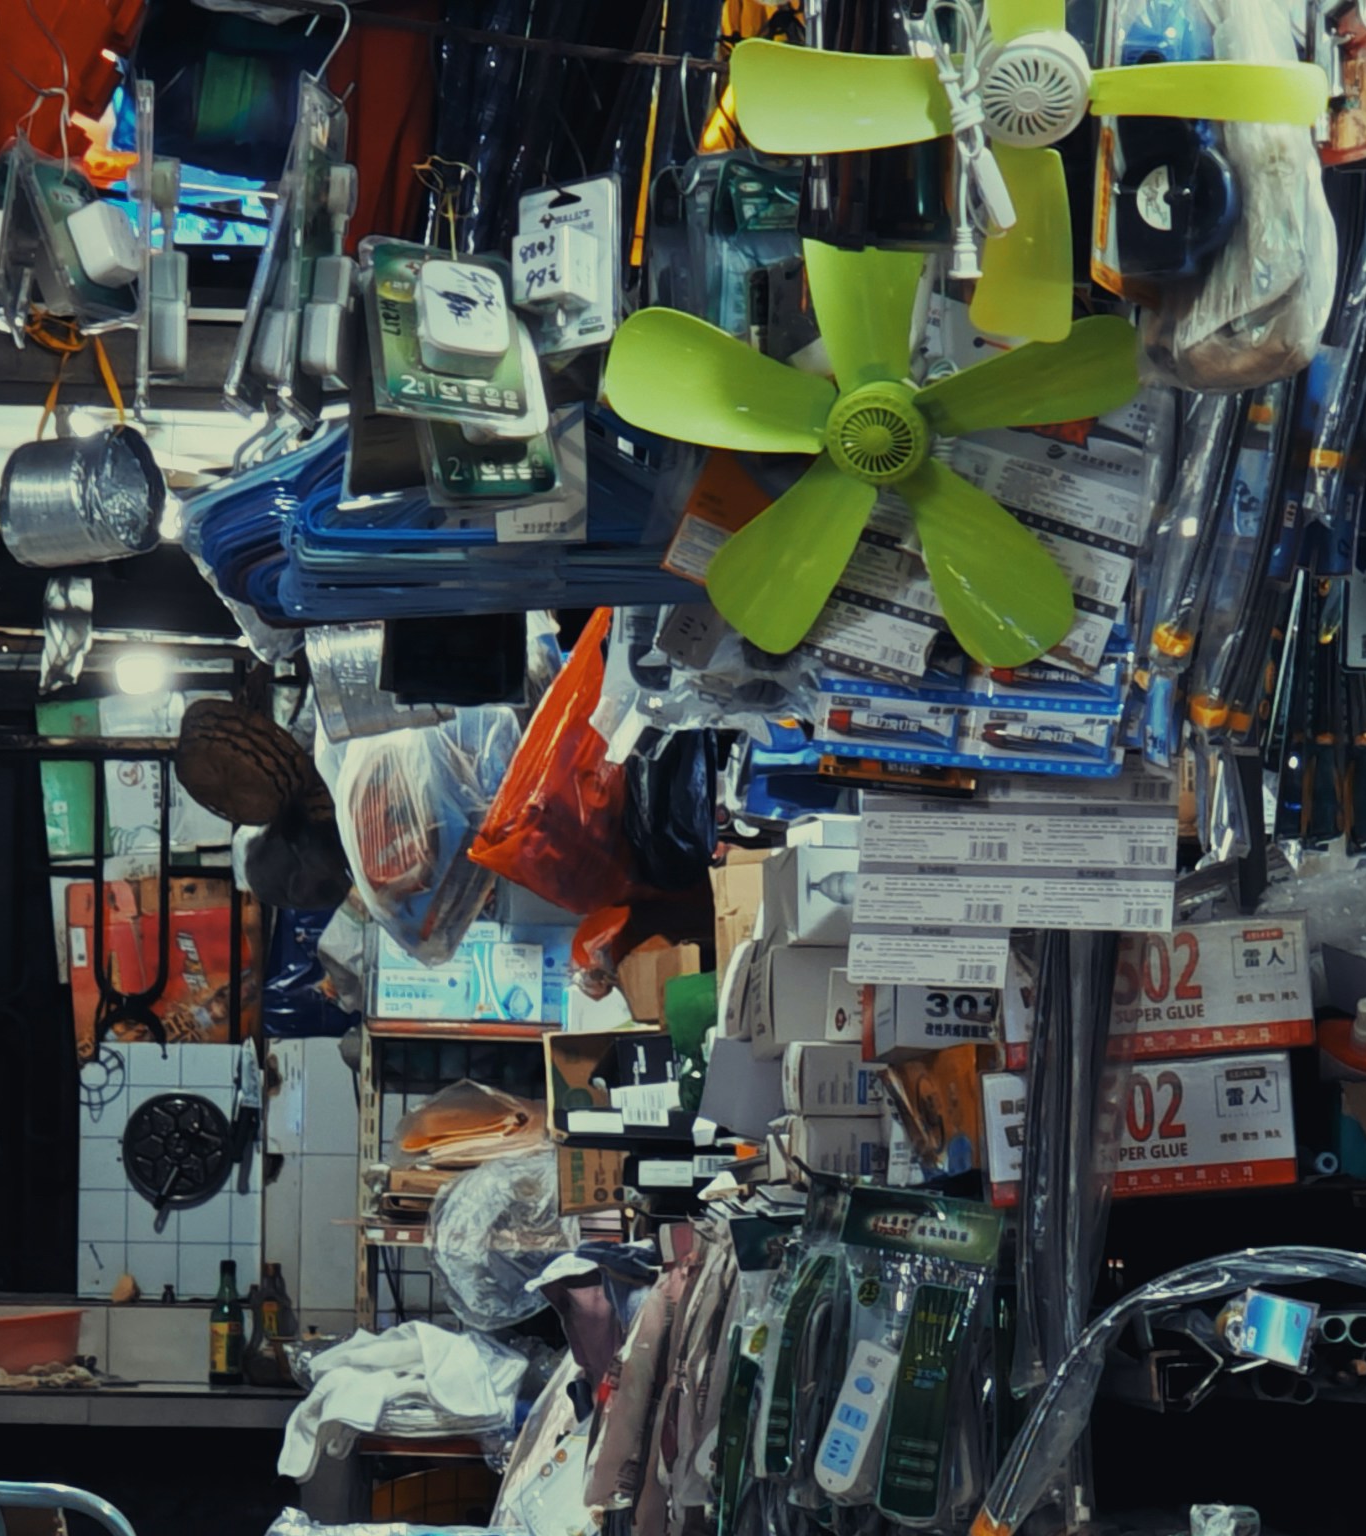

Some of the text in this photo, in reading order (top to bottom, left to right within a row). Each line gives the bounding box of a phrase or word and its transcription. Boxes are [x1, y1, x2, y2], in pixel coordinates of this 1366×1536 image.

[1114, 931, 1203, 1007] 502
[1242, 947, 1286, 969] 雷人
[1114, 1002, 1205, 1024] SUPER GLUE
[1124, 1070, 1186, 1143] 02
[1225, 1086, 1269, 1107] 雷人
[1150, 1143, 1187, 1159] GLUE
